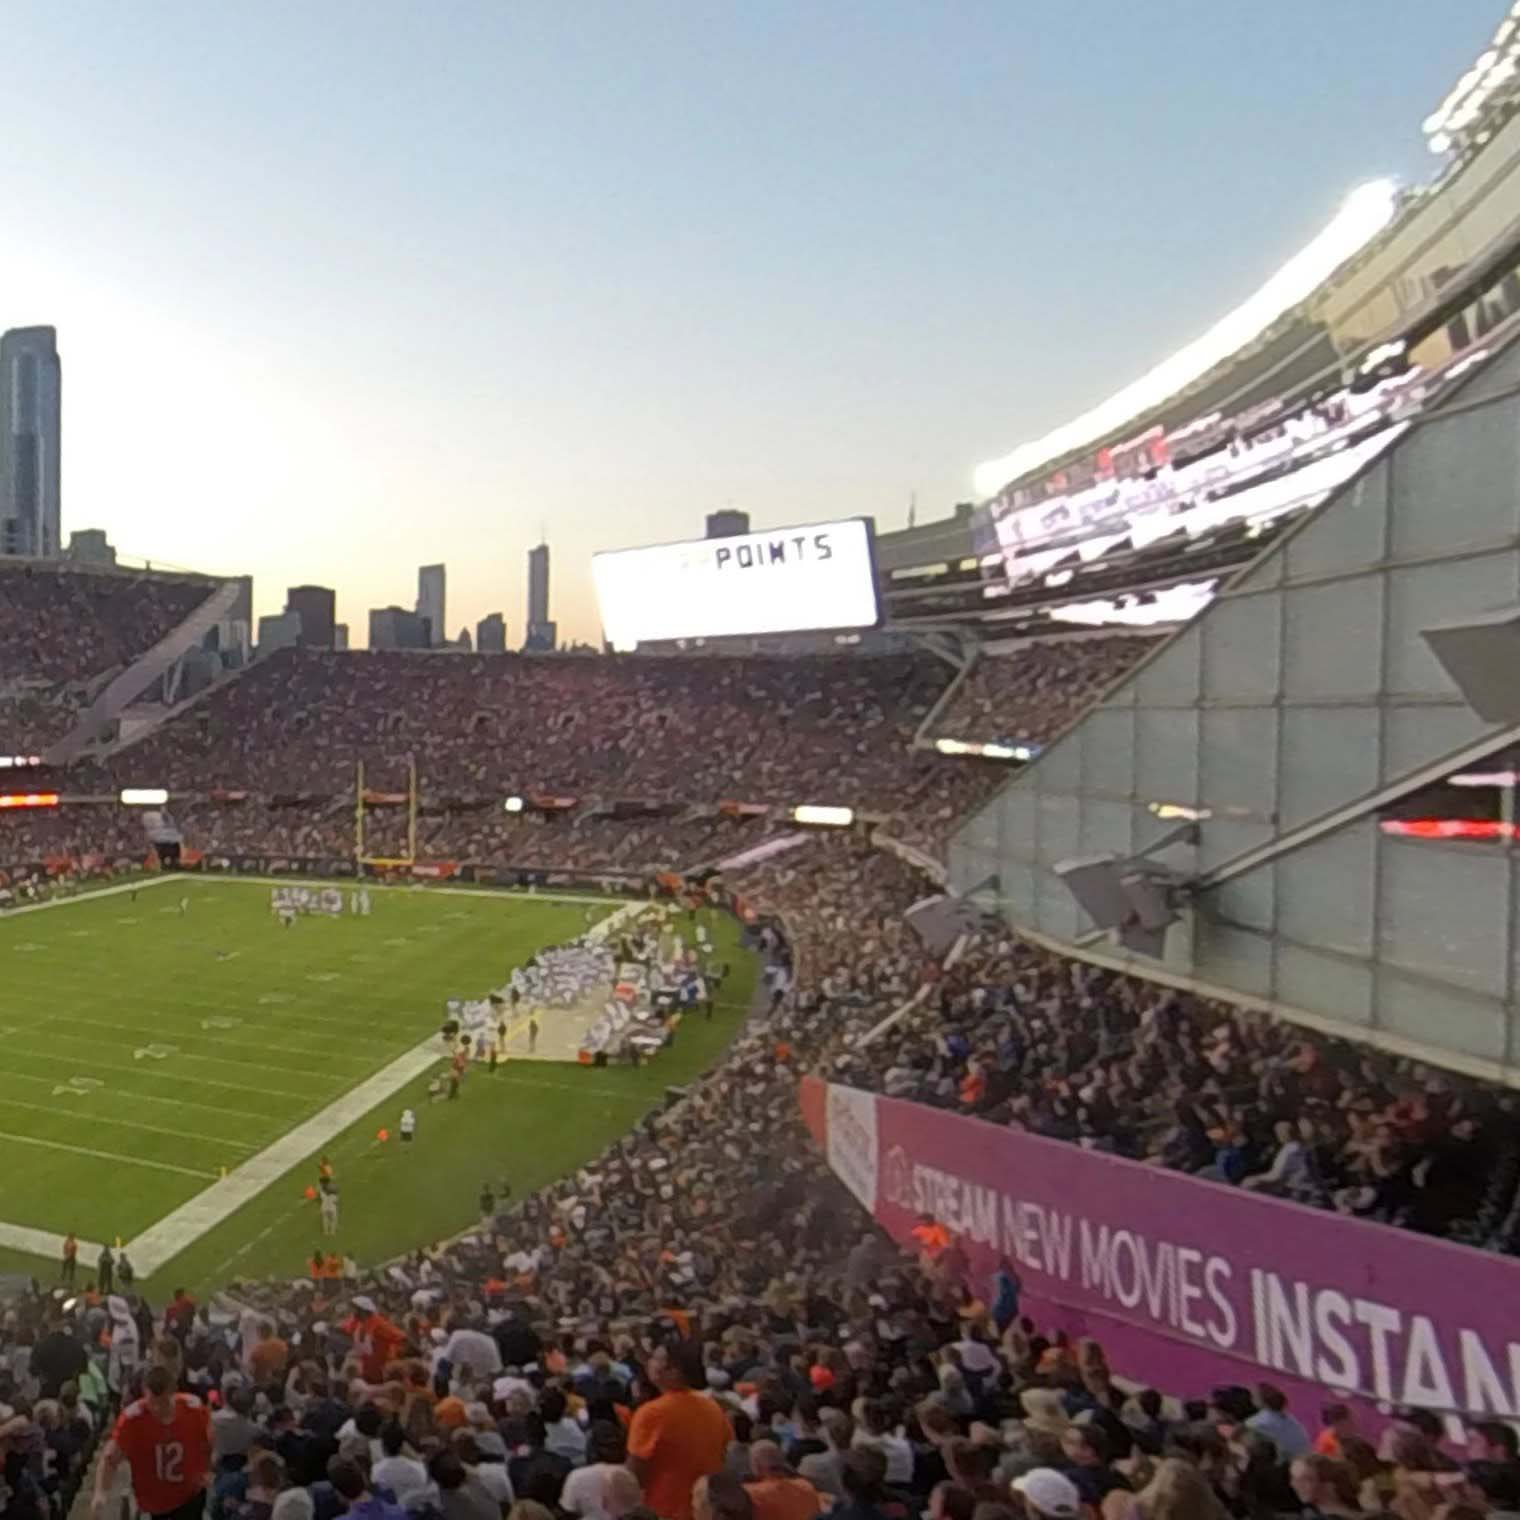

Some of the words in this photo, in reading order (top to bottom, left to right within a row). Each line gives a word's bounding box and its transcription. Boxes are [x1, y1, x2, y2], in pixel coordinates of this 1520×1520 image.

[912, 1163, 1000, 1250] STREAM
[1003, 1195, 1072, 1281] NEW
[1080, 1218, 1237, 1348] MOVIES
[155, 1440, 184, 1482] 12
